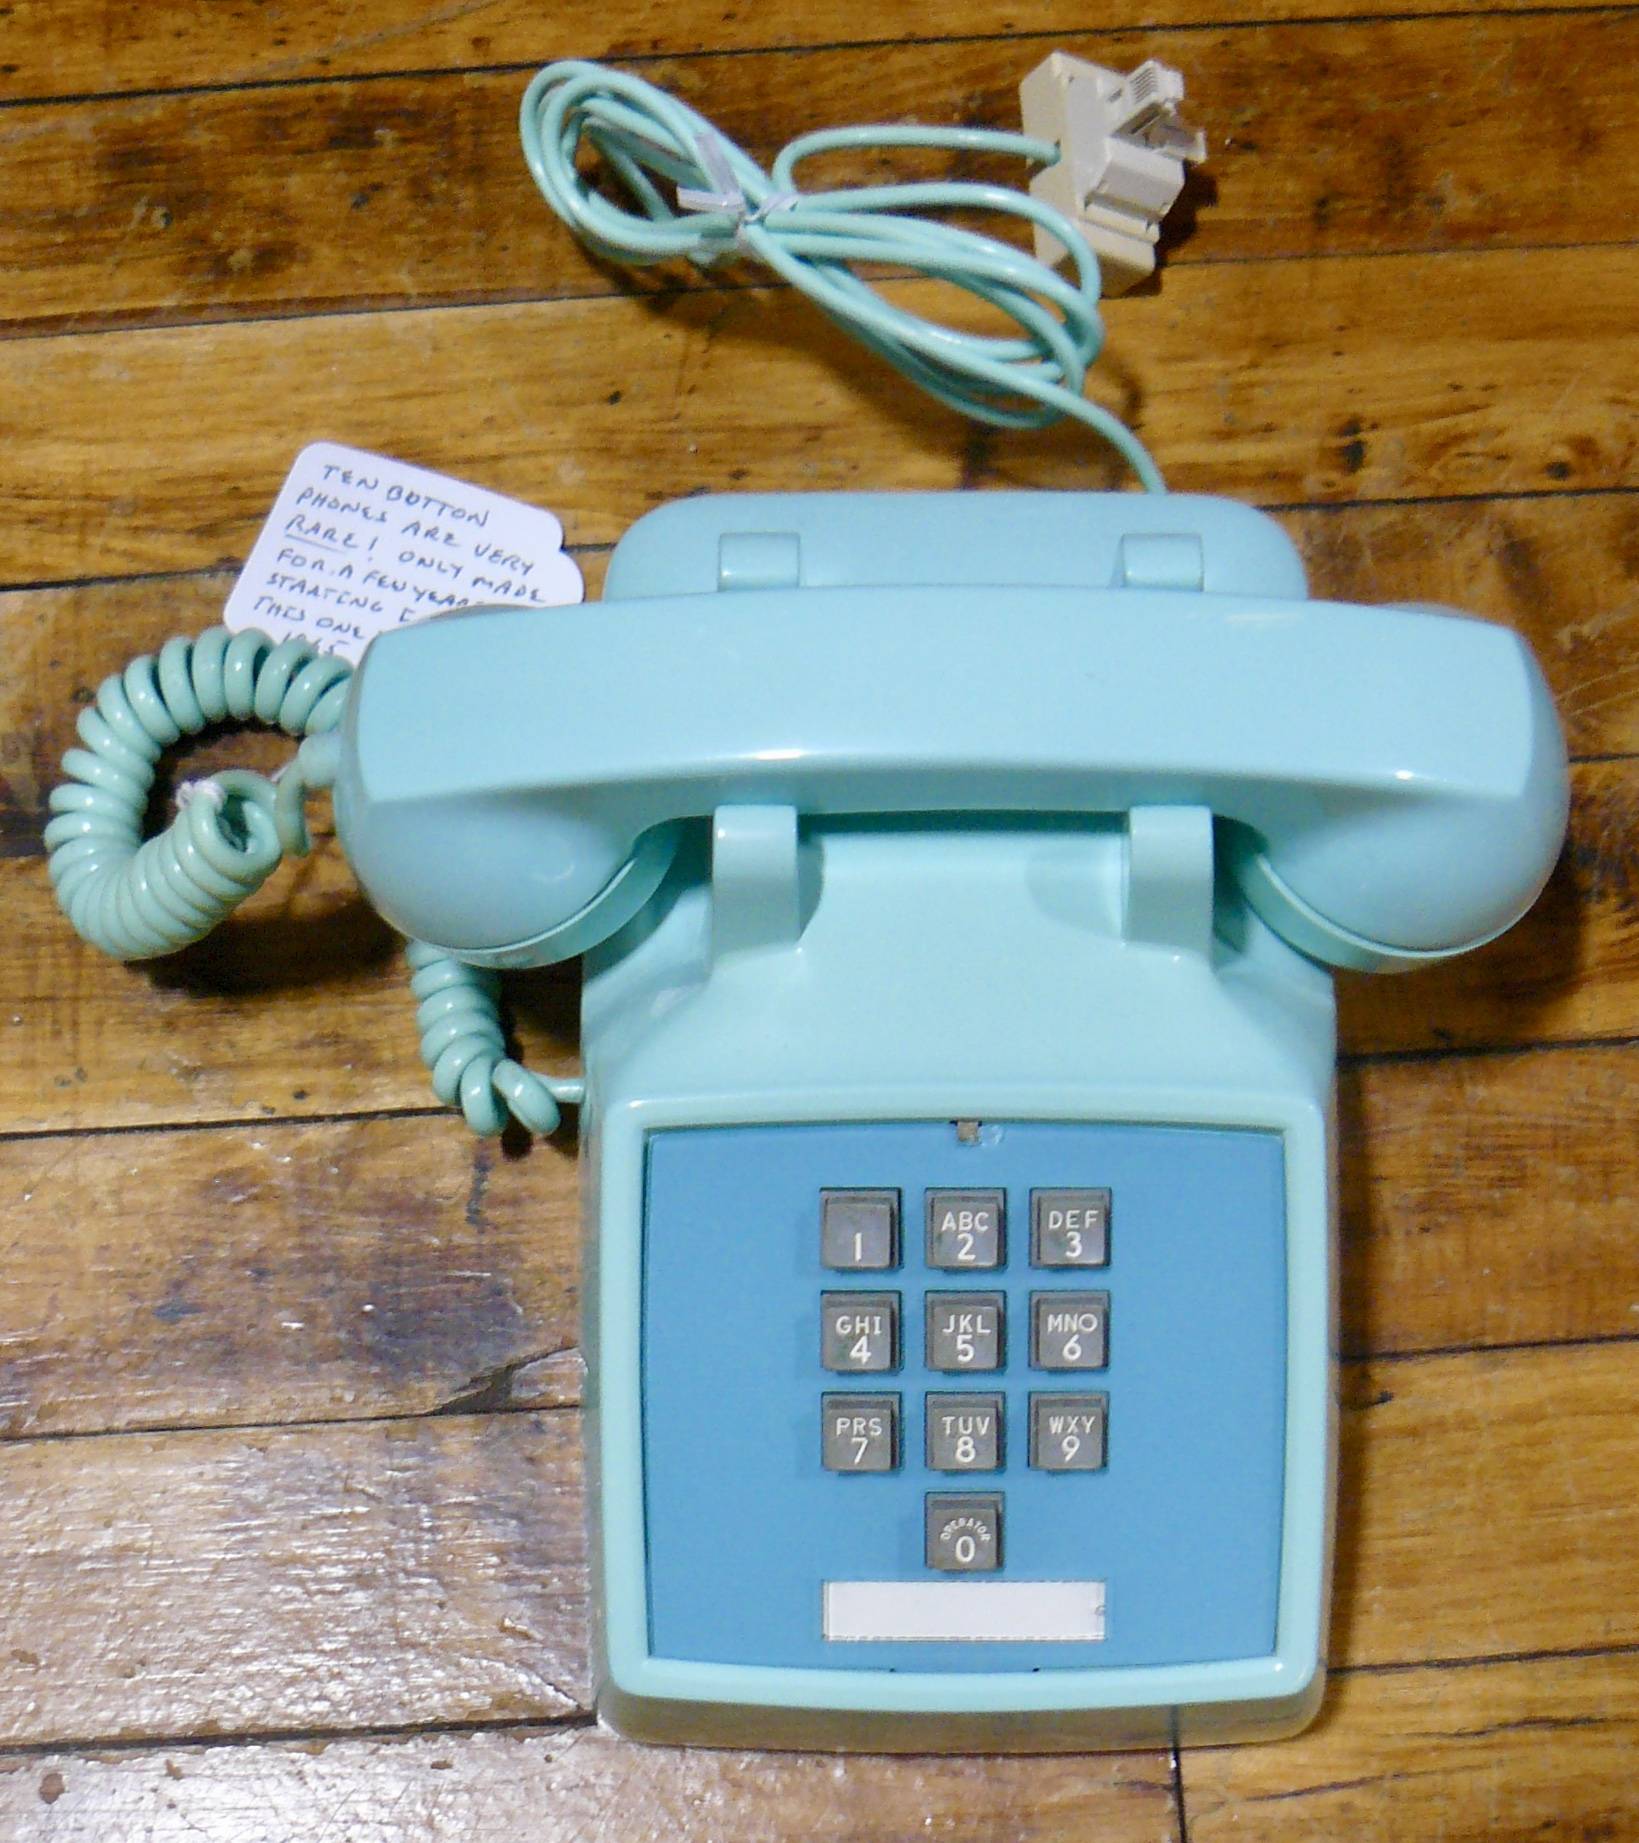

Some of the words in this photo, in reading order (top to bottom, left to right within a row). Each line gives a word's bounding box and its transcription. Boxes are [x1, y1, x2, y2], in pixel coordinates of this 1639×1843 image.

[323, 465, 379, 490] TEN
[296, 487, 387, 522] PHONES
[400, 521, 462, 547] ARE
[474, 542, 534, 576] VERY
[362, 570, 411, 593] FEW
[399, 550, 463, 579] ONLY
[472, 576, 547, 604] MADE
[266, 573, 383, 613] STARTING
[253, 596, 306, 621] THIS
[316, 614, 365, 640] ONE
[942, 1211, 989, 1232] ABC
[1048, 1210, 1099, 1230] DEF
[854, 1232, 862, 1261] 1
[957, 1234, 976, 1260] 2
[1065, 1231, 1083, 1257] 3
[836, 1316, 882, 1335] GHI
[942, 1315, 990, 1334] JKL
[1047, 1313, 1098, 1333] MNO
[849, 1335, 871, 1365] 4
[957, 1333, 975, 1362] 5
[1062, 1334, 1080, 1360] 6
[836, 1418, 882, 1436] PRS
[942, 1416, 991, 1435] TUV
[1049, 1415, 1095, 1433] WXY
[850, 1436, 869, 1464] 7
[956, 1436, 976, 1462] 8
[1061, 1435, 1080, 1461] 9
[940, 1517, 991, 1542] OPERATOR
